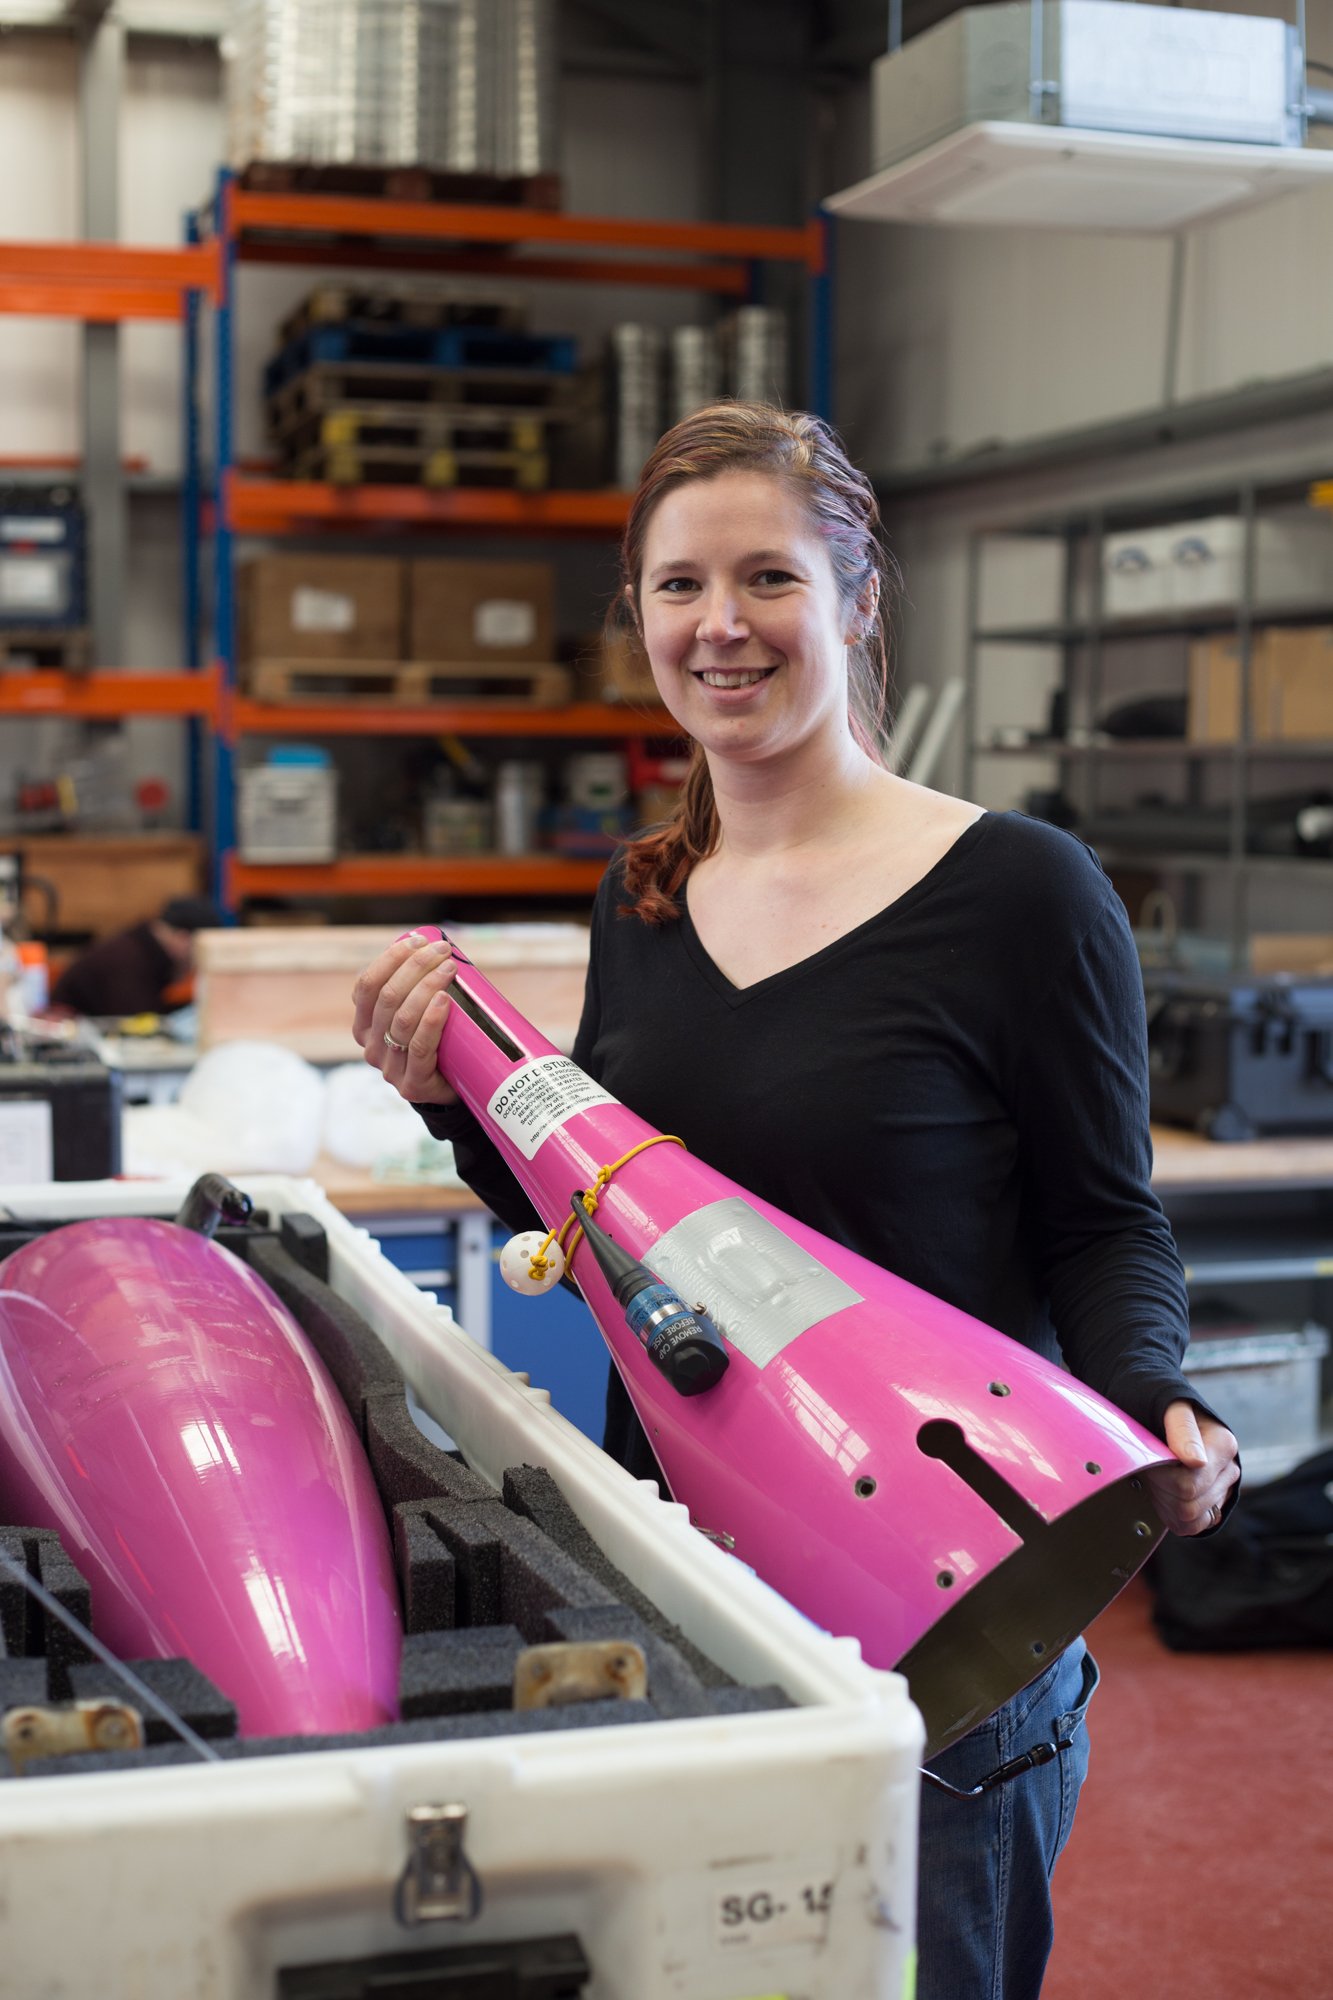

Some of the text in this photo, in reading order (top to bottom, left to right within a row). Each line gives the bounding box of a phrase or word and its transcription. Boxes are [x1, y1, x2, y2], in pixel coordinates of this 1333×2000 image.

[495, 1096, 509, 1114] DO
[508, 1074, 531, 1097] NOT
[517, 1077, 548, 1099] RESEARC
[518, 1091, 546, 1118] REMOVING
[546, 1082, 563, 1093] FRM
[542, 1086, 572, 1103] Fabriction
[512, 1101, 525, 1116] CALL
[527, 1102, 553, 1126] Univity
[652, 1316, 696, 1351] BEFORE USE
[659, 1324, 703, 1360] REMOVE CAP
